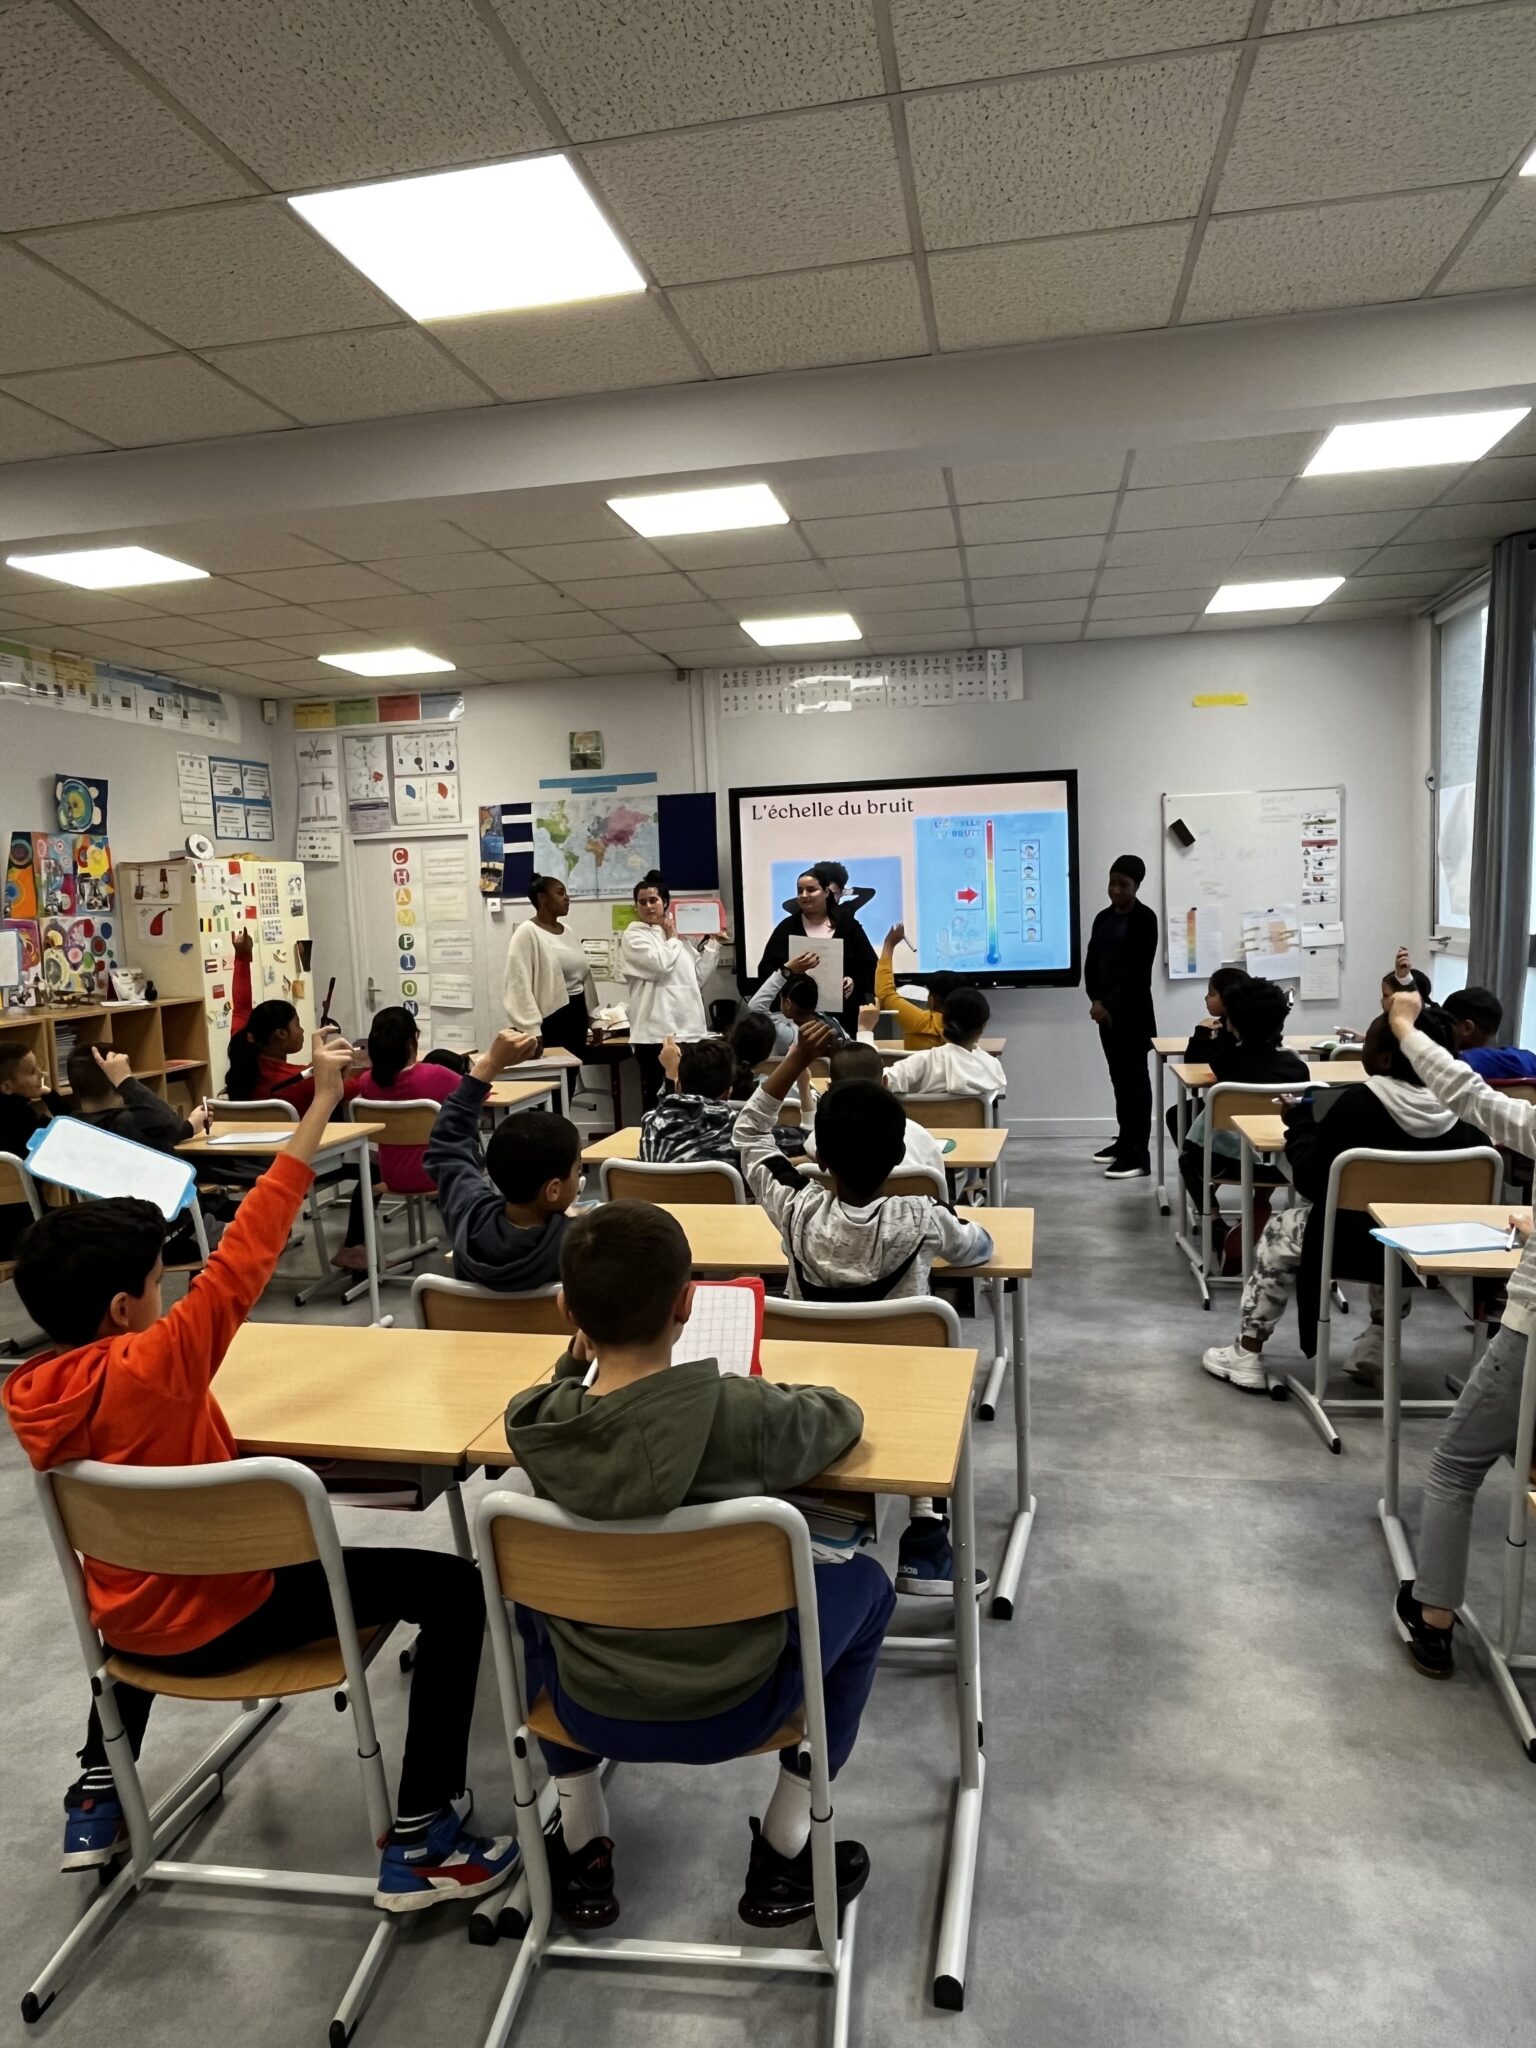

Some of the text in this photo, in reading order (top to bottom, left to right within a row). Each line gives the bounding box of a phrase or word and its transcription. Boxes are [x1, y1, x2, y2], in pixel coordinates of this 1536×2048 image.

[752, 798, 914, 820] L'échelle du bruit
